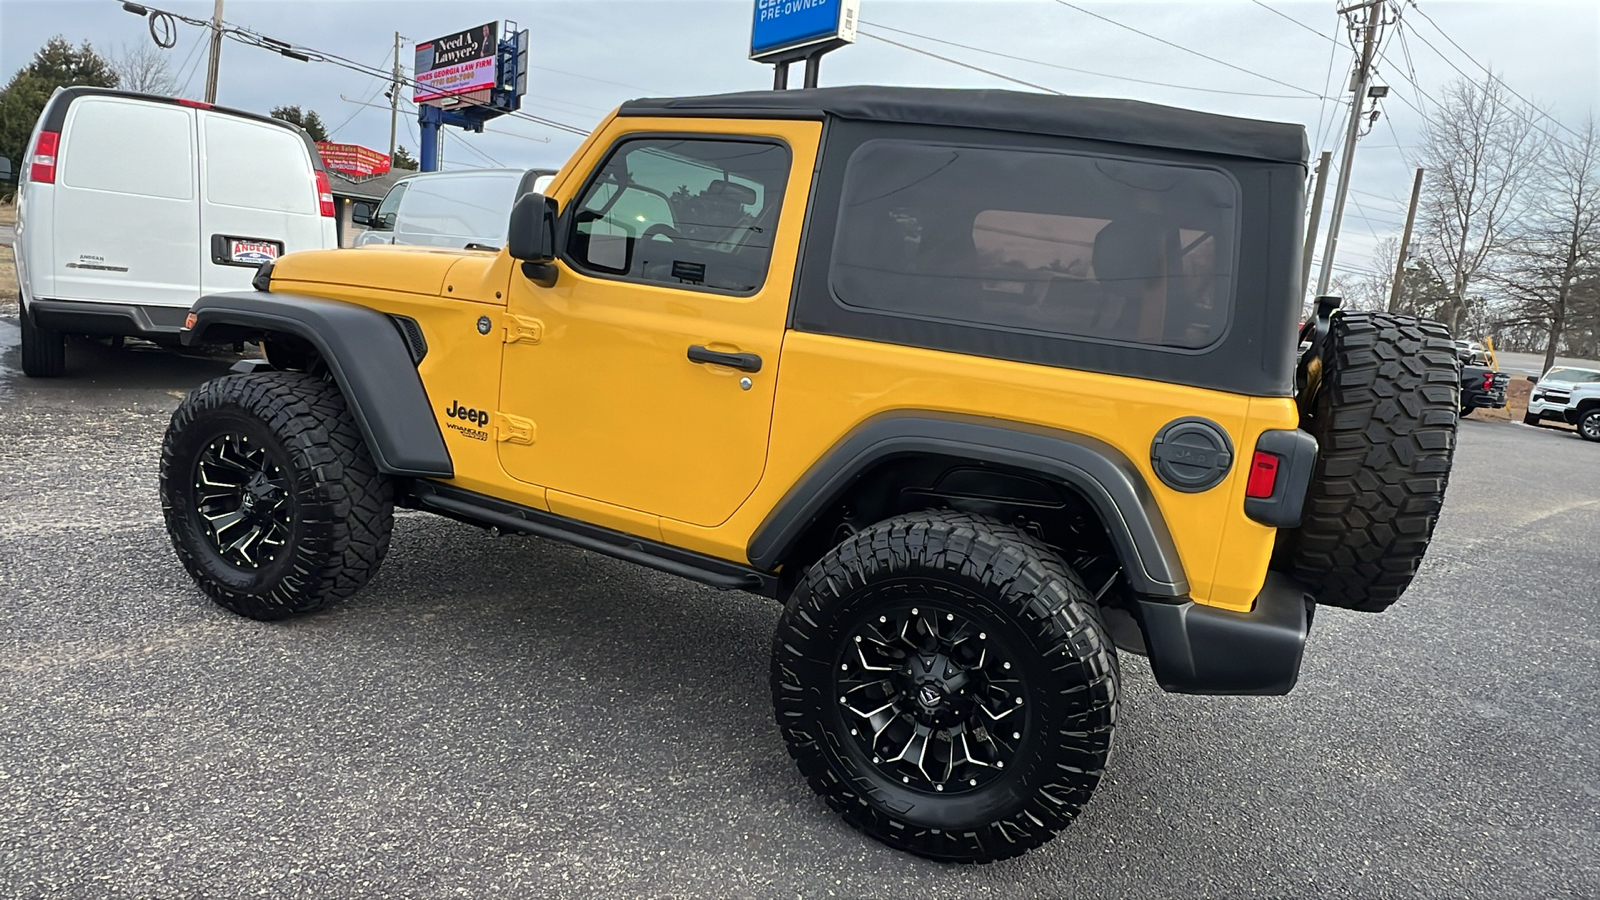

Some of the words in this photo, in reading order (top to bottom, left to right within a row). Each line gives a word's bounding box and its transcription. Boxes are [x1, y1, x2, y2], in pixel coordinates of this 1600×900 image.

[439, 34, 463, 52] Need
[465, 32, 472, 45] A
[435, 41, 479, 64] Lawyer?
[434, 66, 460, 79] GEORGIA
[460, 63, 475, 73] LAW
[475, 59, 492, 70] FIRM
[79, 254, 105, 262] ANDEAN
[234, 242, 276, 258] ANDEAN
[446, 400, 489, 428] Jeep
